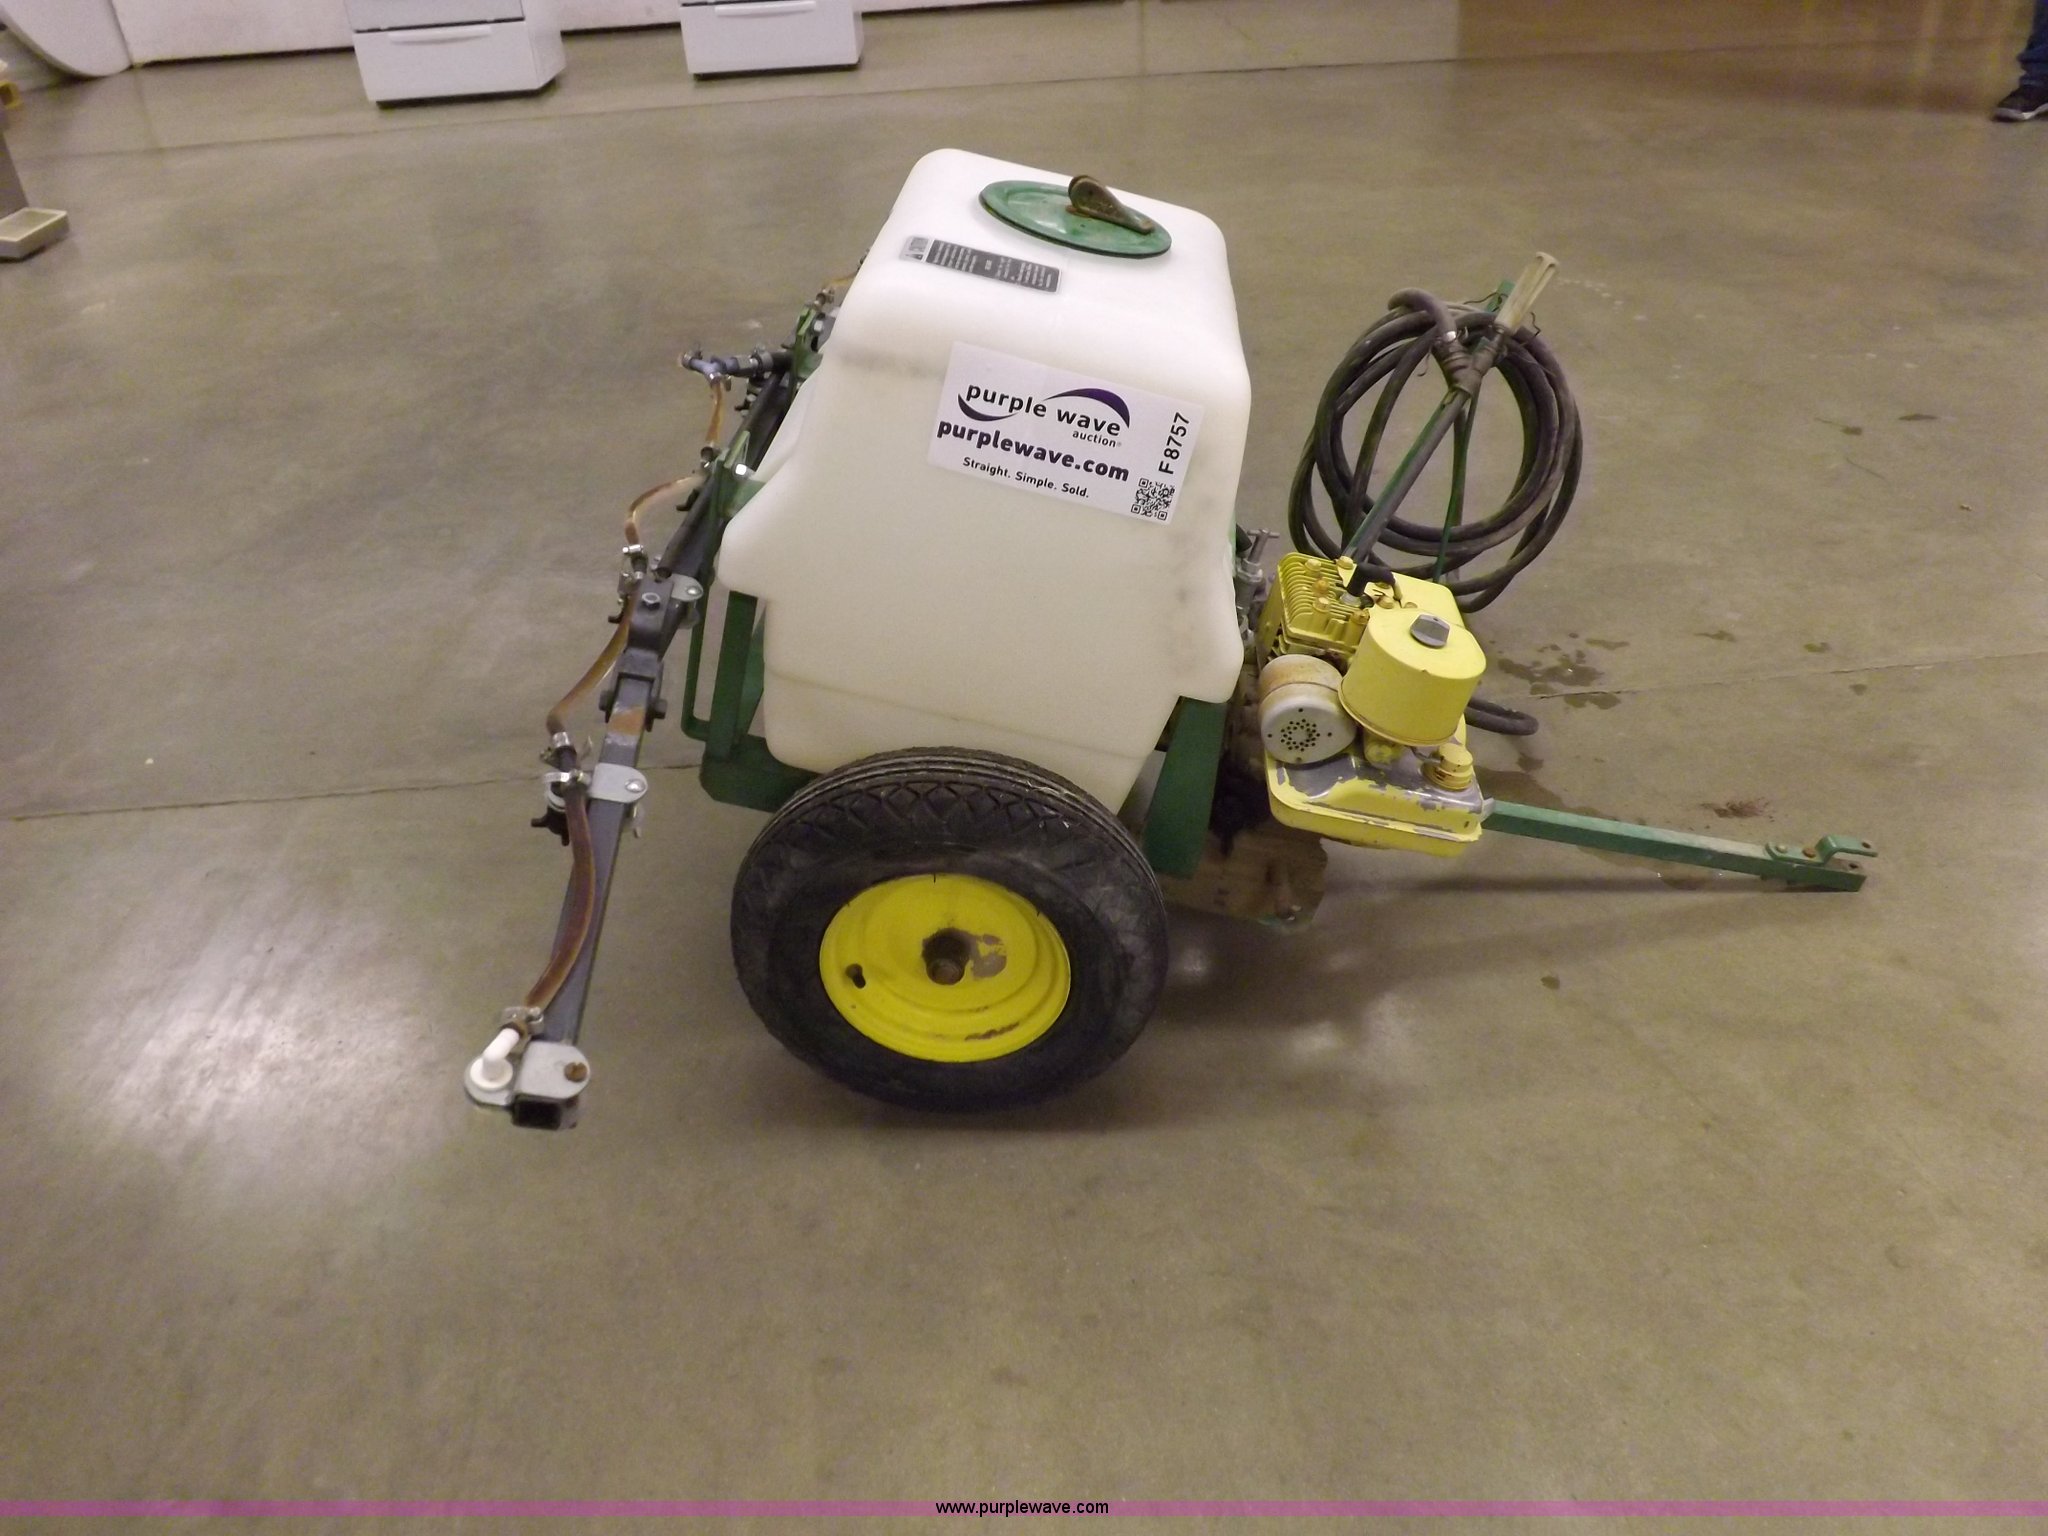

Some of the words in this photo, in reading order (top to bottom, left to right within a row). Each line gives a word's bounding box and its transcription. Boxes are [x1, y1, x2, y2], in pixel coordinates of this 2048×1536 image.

[965, 384, 1047, 417] purple
[1056, 407, 1121, 436] wave
[936, 420, 1129, 482] purplewave.com
[1158, 411, 1191, 475] F8757
[962, 456, 1011, 479] Straight.
[1014, 471, 1057, 491] Simple.
[1061, 482, 1090, 498] Sold.
